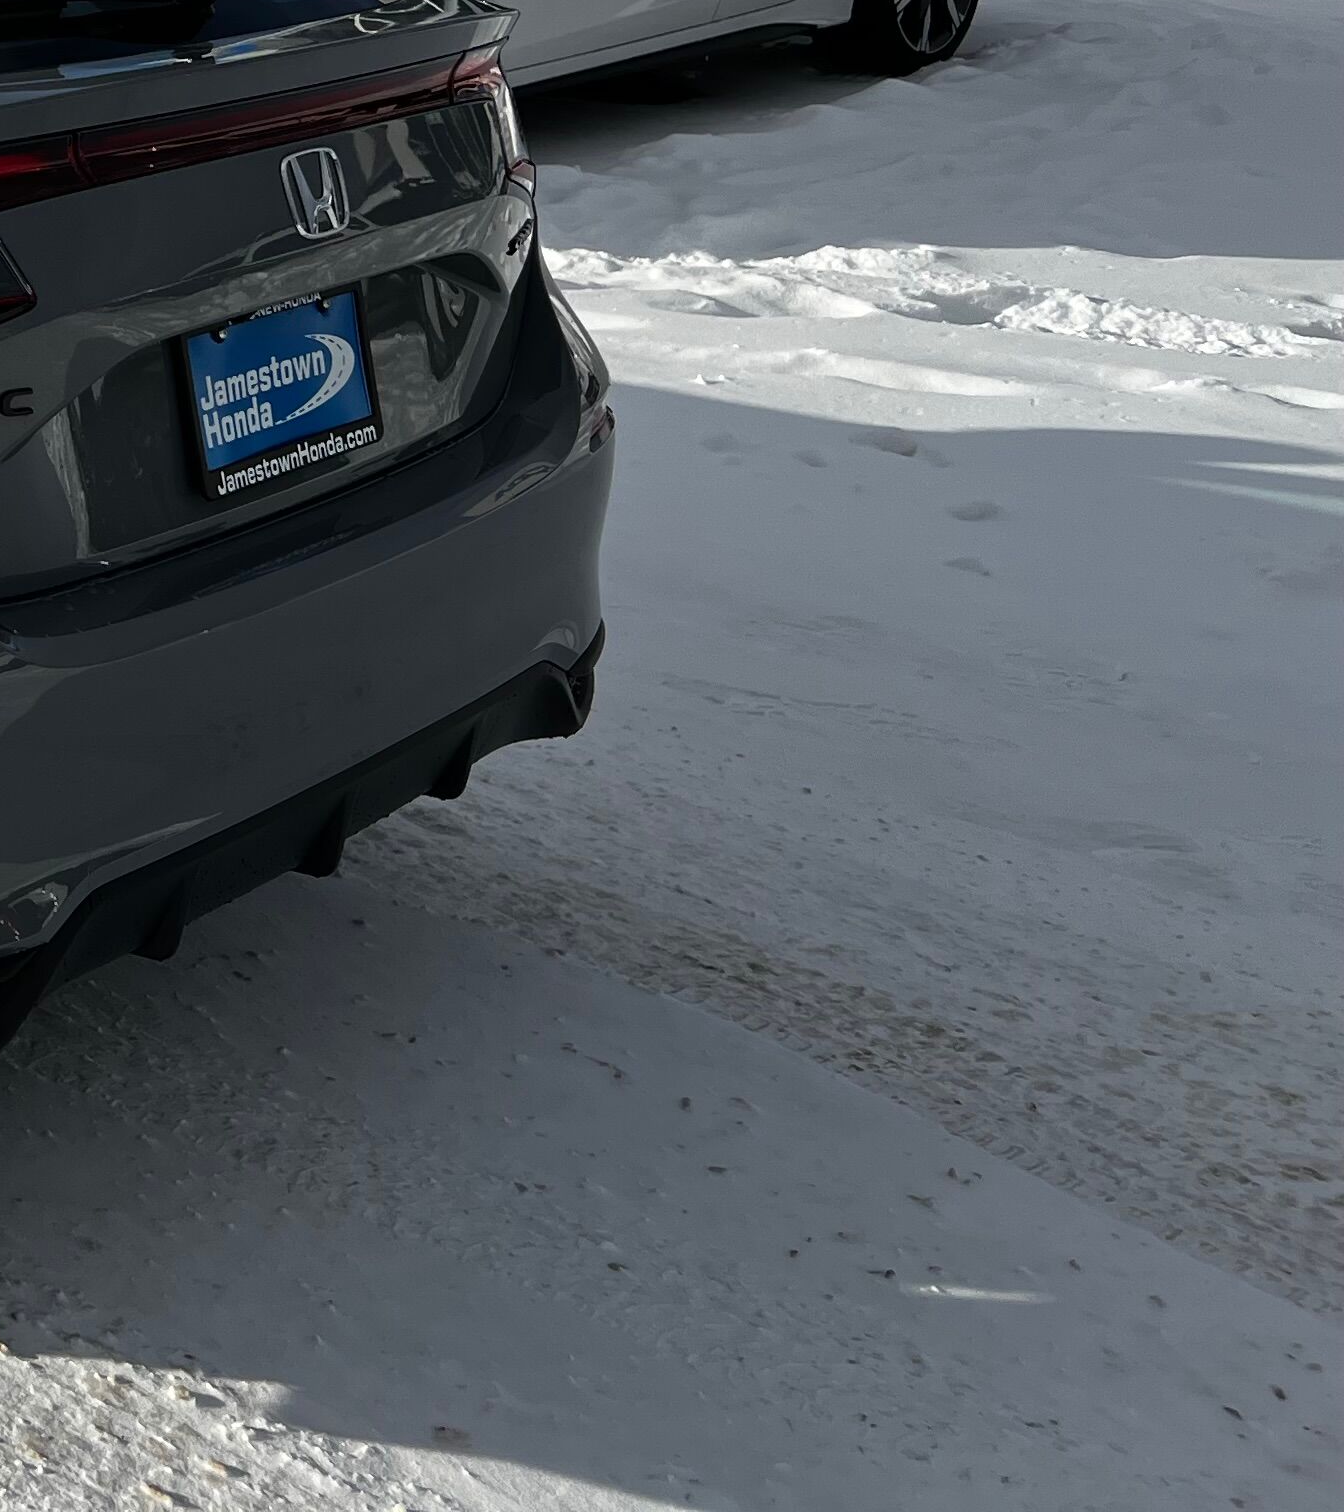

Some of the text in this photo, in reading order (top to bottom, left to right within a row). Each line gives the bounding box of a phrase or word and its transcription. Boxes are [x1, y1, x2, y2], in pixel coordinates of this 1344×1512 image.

[200, 349, 326, 411] Jamestown
[202, 396, 274, 449] Honda
[217, 424, 377, 496] JamestownHonda.com
